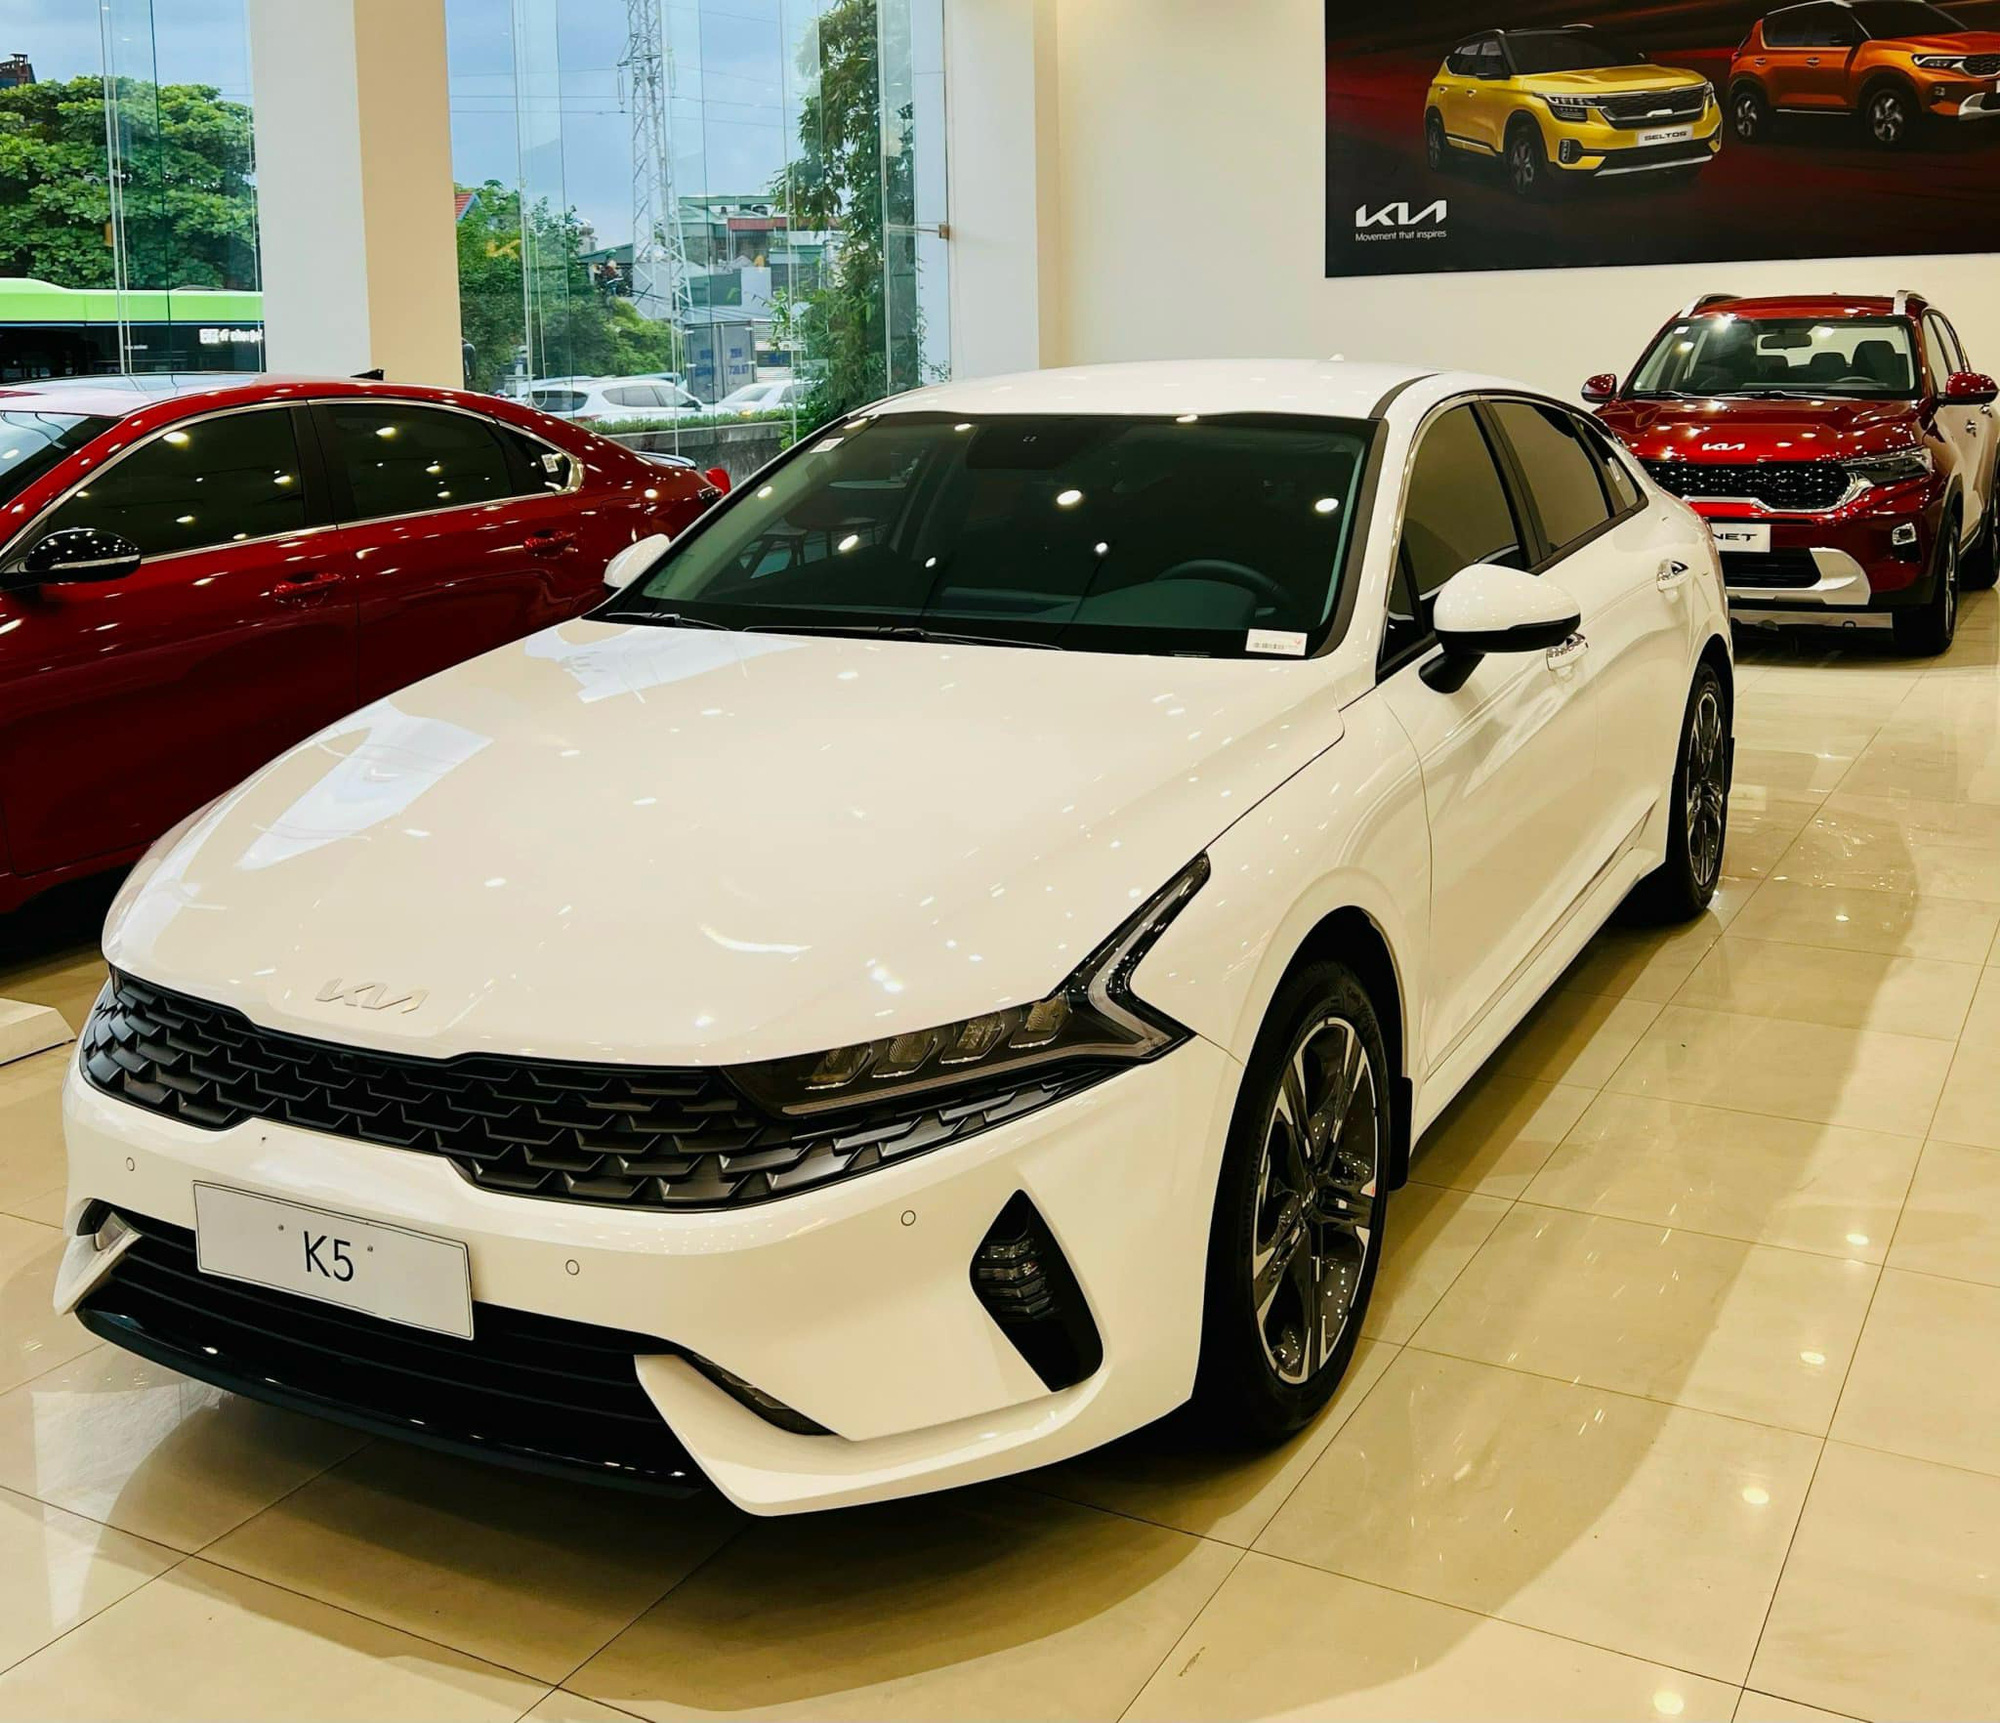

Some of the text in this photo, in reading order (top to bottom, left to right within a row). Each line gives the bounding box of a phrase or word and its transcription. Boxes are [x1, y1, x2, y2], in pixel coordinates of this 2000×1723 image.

[1644, 130, 1688, 141] SELTOS
[1355, 199, 1447, 228] KIA
[1355, 230, 1447, 242] Movement that inspires
[1701, 442, 1746, 451] KIA
[1713, 532, 1758, 542] NET
[315, 976, 430, 1015] KIA
[303, 1230, 354, 1282] K5
